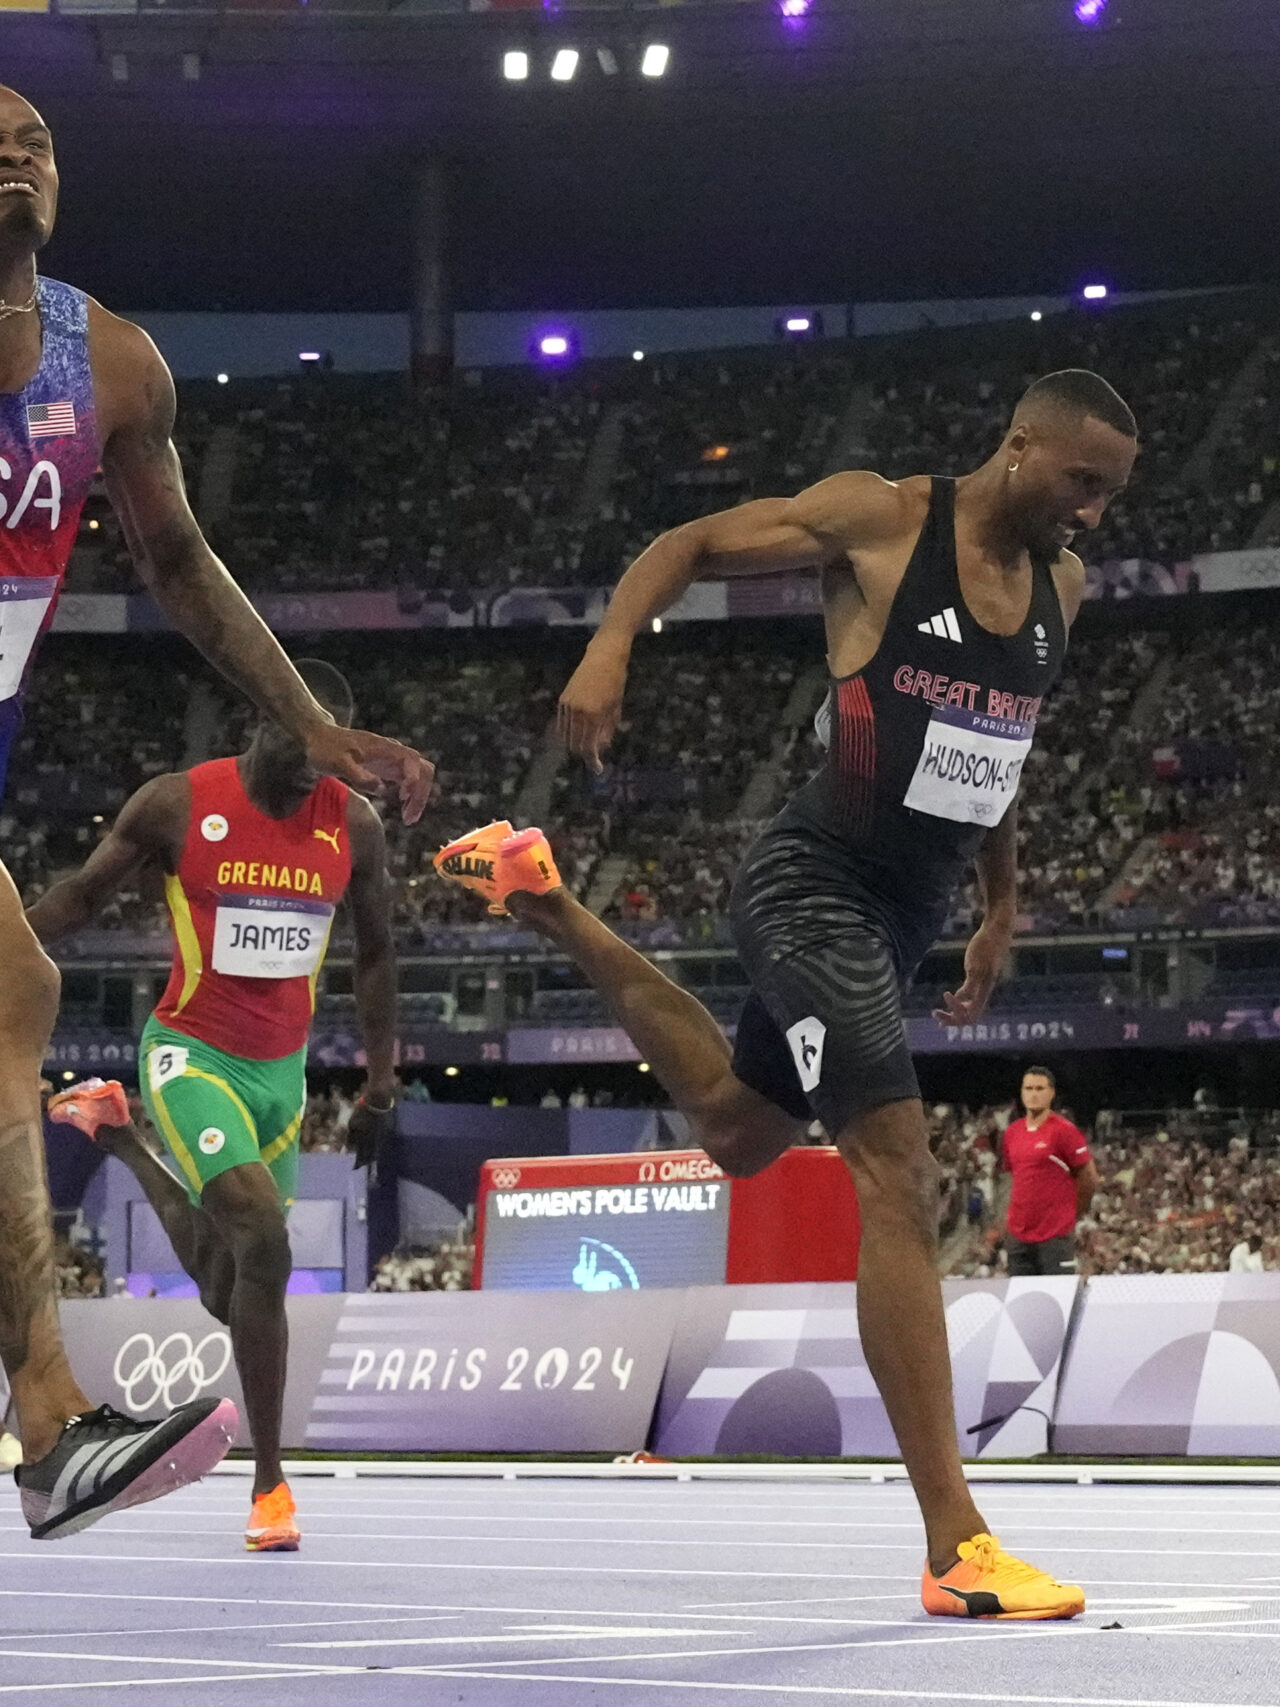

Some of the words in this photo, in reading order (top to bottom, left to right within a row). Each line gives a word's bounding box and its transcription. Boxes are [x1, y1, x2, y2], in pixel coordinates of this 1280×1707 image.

[893, 664, 981, 711] GREAT
[987, 688, 1043, 724] BRITA
[972, 716, 1007, 733] PARIS
[217, 861, 323, 896] GRENADA
[230, 923, 311, 951] JAMES
[946, 1022, 1011, 1042] PARIS
[1017, 1021, 1075, 1040] 2024
[158, 1052, 173, 1076] 5
[659, 1159, 723, 1182] OMEGA
[594, 1187, 649, 1215] POLE
[651, 1184, 721, 1212] VAULT
[346, 1347, 487, 1391] PARIS
[499, 1347, 634, 1391] 2024
